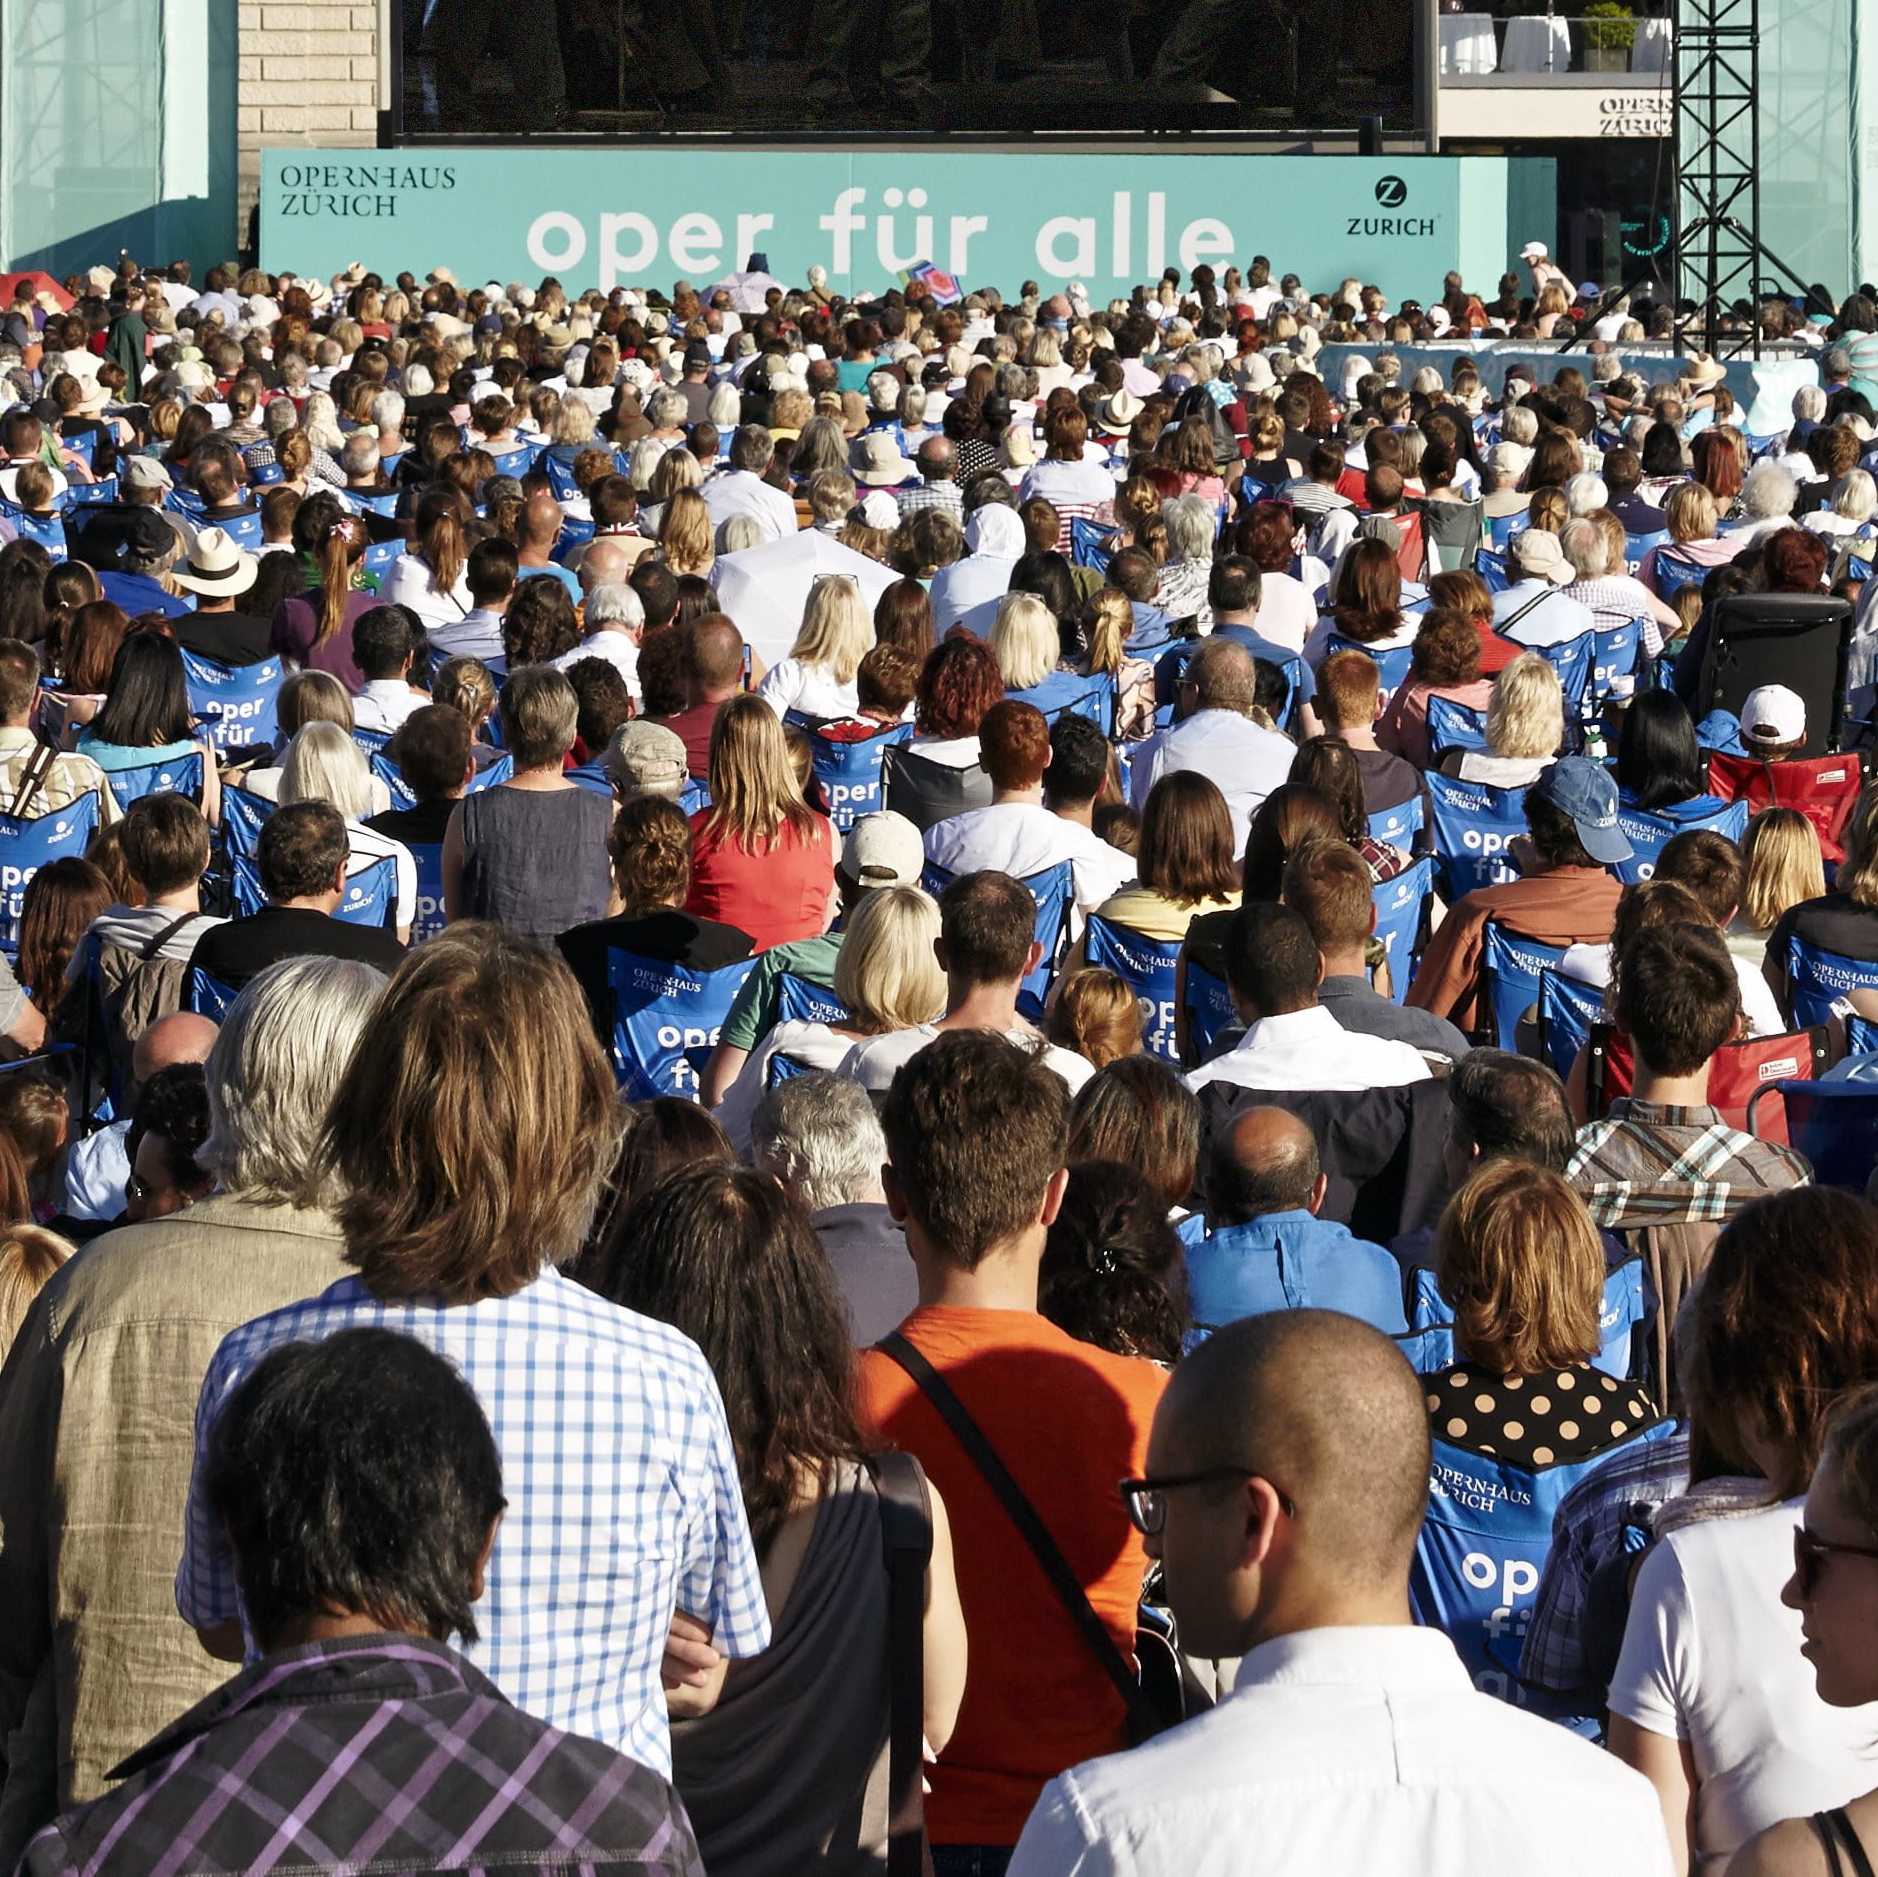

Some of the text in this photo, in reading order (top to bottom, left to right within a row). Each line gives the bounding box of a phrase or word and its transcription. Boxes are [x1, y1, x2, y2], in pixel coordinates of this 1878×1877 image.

[1599, 97, 1673, 115] OPERN
[280, 165, 456, 189] OPERNHAUS
[280, 189, 396, 217] ZÜRICH
[526, 187, 1236, 292] oper für alle
[1347, 218, 1434, 236] ZURICH
[207, 698, 265, 726] oper
[215, 722, 255, 745] für
[343, 895, 374, 913] ZURICH
[633, 967, 702, 994] OPERNHAUS
[1138, 996, 1177, 1030] op
[1431, 1462, 1531, 1506] OPERNHAUS
[1461, 1551, 1539, 1605] op
